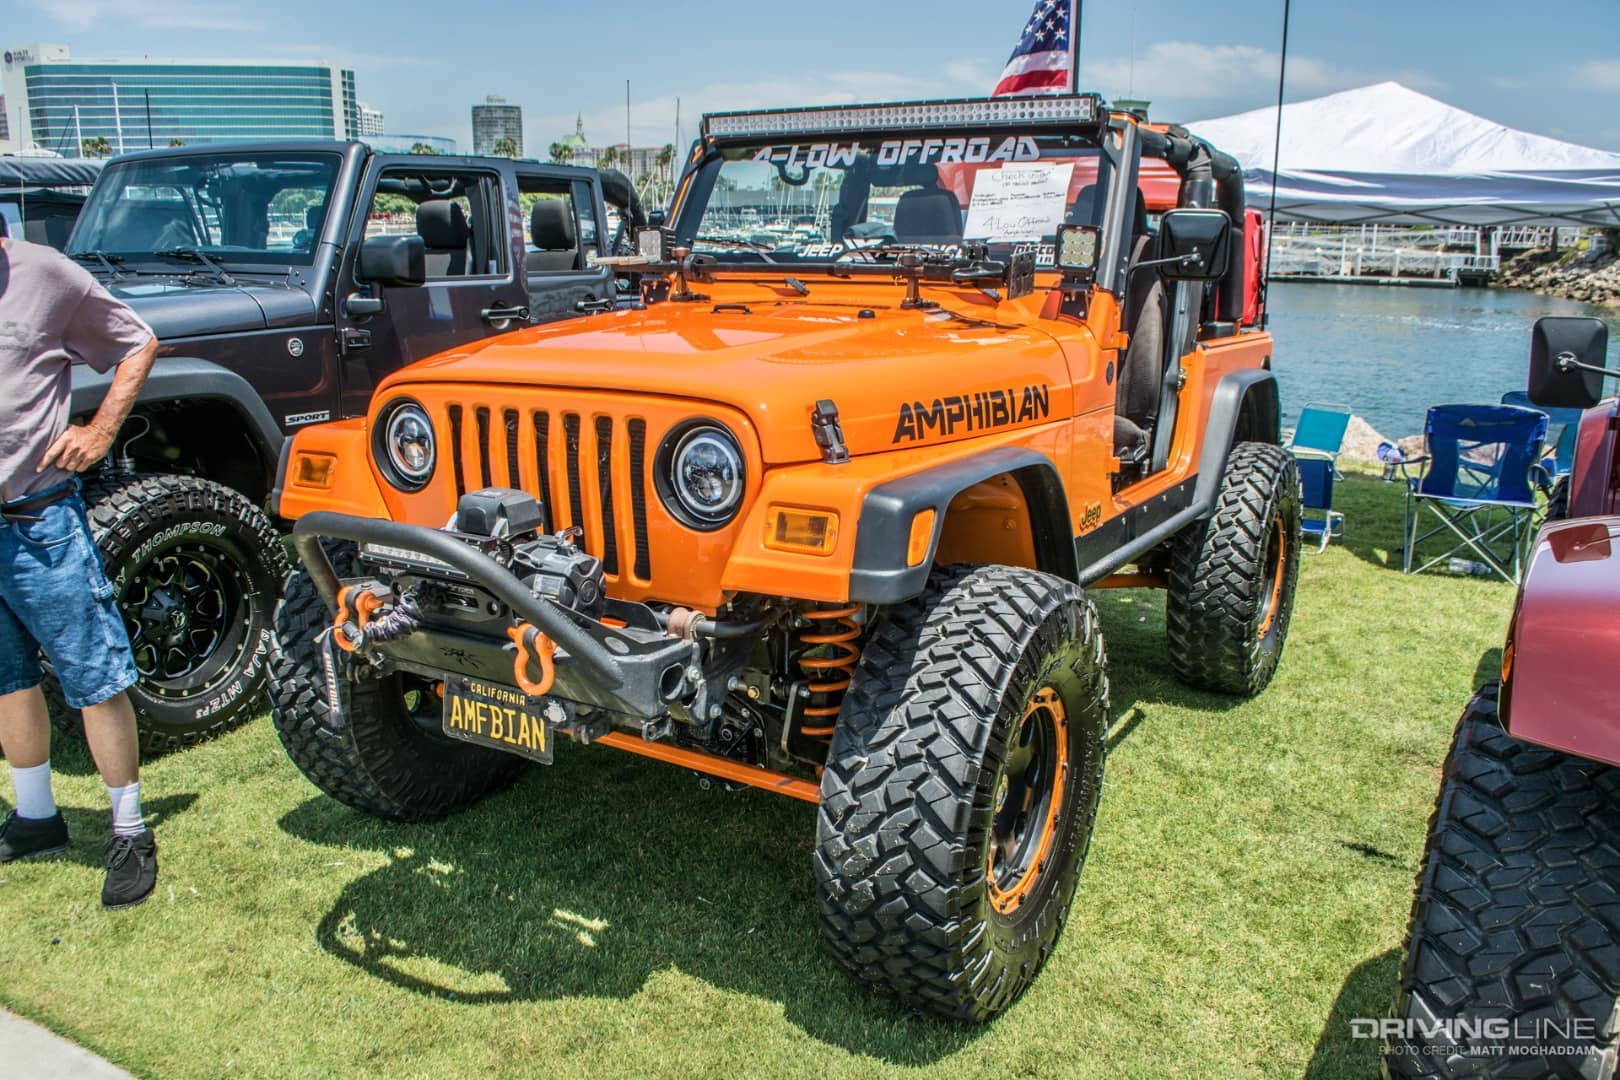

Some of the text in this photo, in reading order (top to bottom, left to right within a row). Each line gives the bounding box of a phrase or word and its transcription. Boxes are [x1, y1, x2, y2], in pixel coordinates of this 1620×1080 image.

[876, 136, 1040, 166] OFFROAD
[798, 244, 844, 258] JEEP
[287, 412, 330, 424] SPORT
[892, 384, 1050, 444] AMPHIBIAN
[1081, 503, 1103, 527] Jeep
[131, 521, 227, 564] THOMPSON
[470, 682, 526, 706] CALIFORNIA
[450, 694, 546, 753] AMFBIAN
